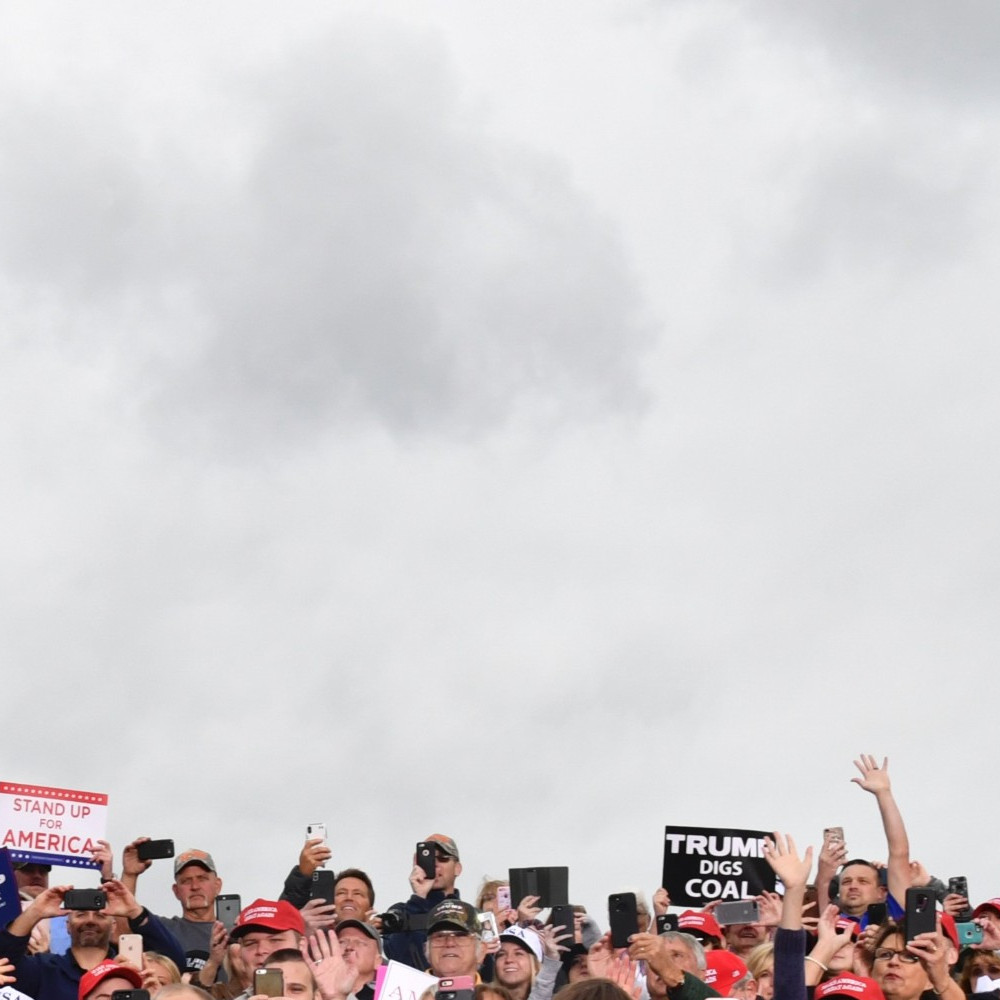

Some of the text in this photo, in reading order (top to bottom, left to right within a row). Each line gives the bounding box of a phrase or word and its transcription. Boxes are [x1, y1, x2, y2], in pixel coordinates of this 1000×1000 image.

[13, 798, 91, 818] STAND UP
[40, 819, 62, 829] FOR
[2, 829, 95, 854] AMERICA
[699, 860, 743, 876] DIGS
[685, 878, 756, 900] COAL
